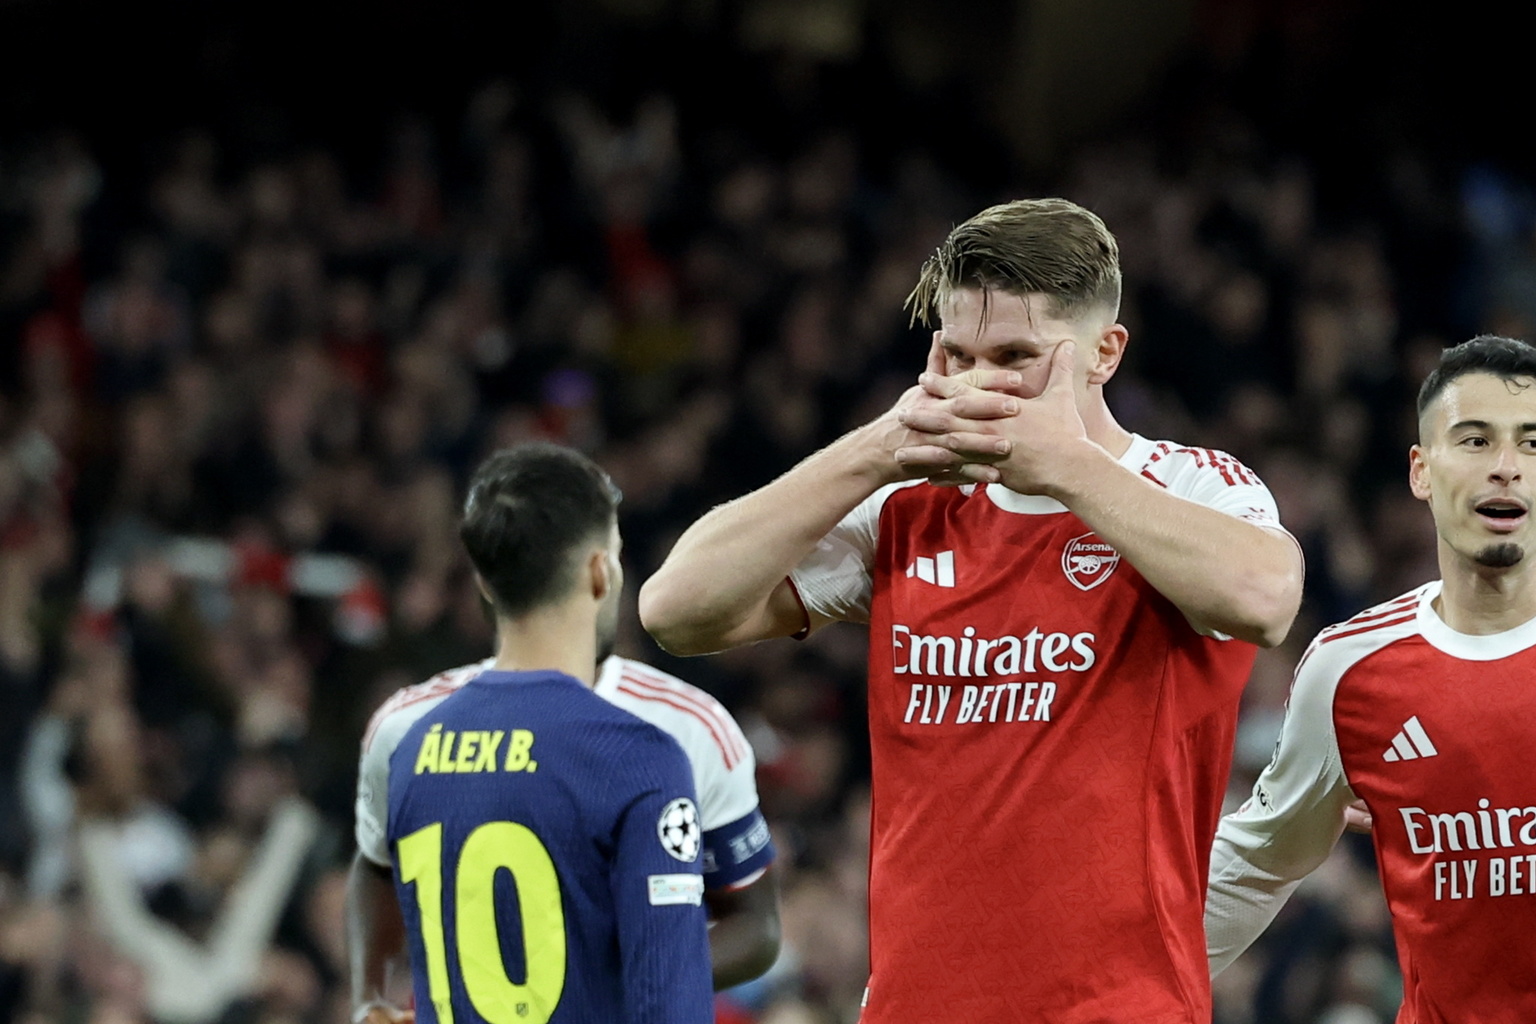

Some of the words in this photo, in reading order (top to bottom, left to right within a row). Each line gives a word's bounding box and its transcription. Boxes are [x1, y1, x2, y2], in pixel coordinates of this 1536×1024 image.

[1072, 543, 1114, 552] Arsena
[904, 683, 951, 724] FLY
[956, 682, 1057, 724] BETTER
[414, 723, 505, 775] ÁLEX
[504, 729, 538, 773] B.
[1434, 859, 1477, 901] FLY
